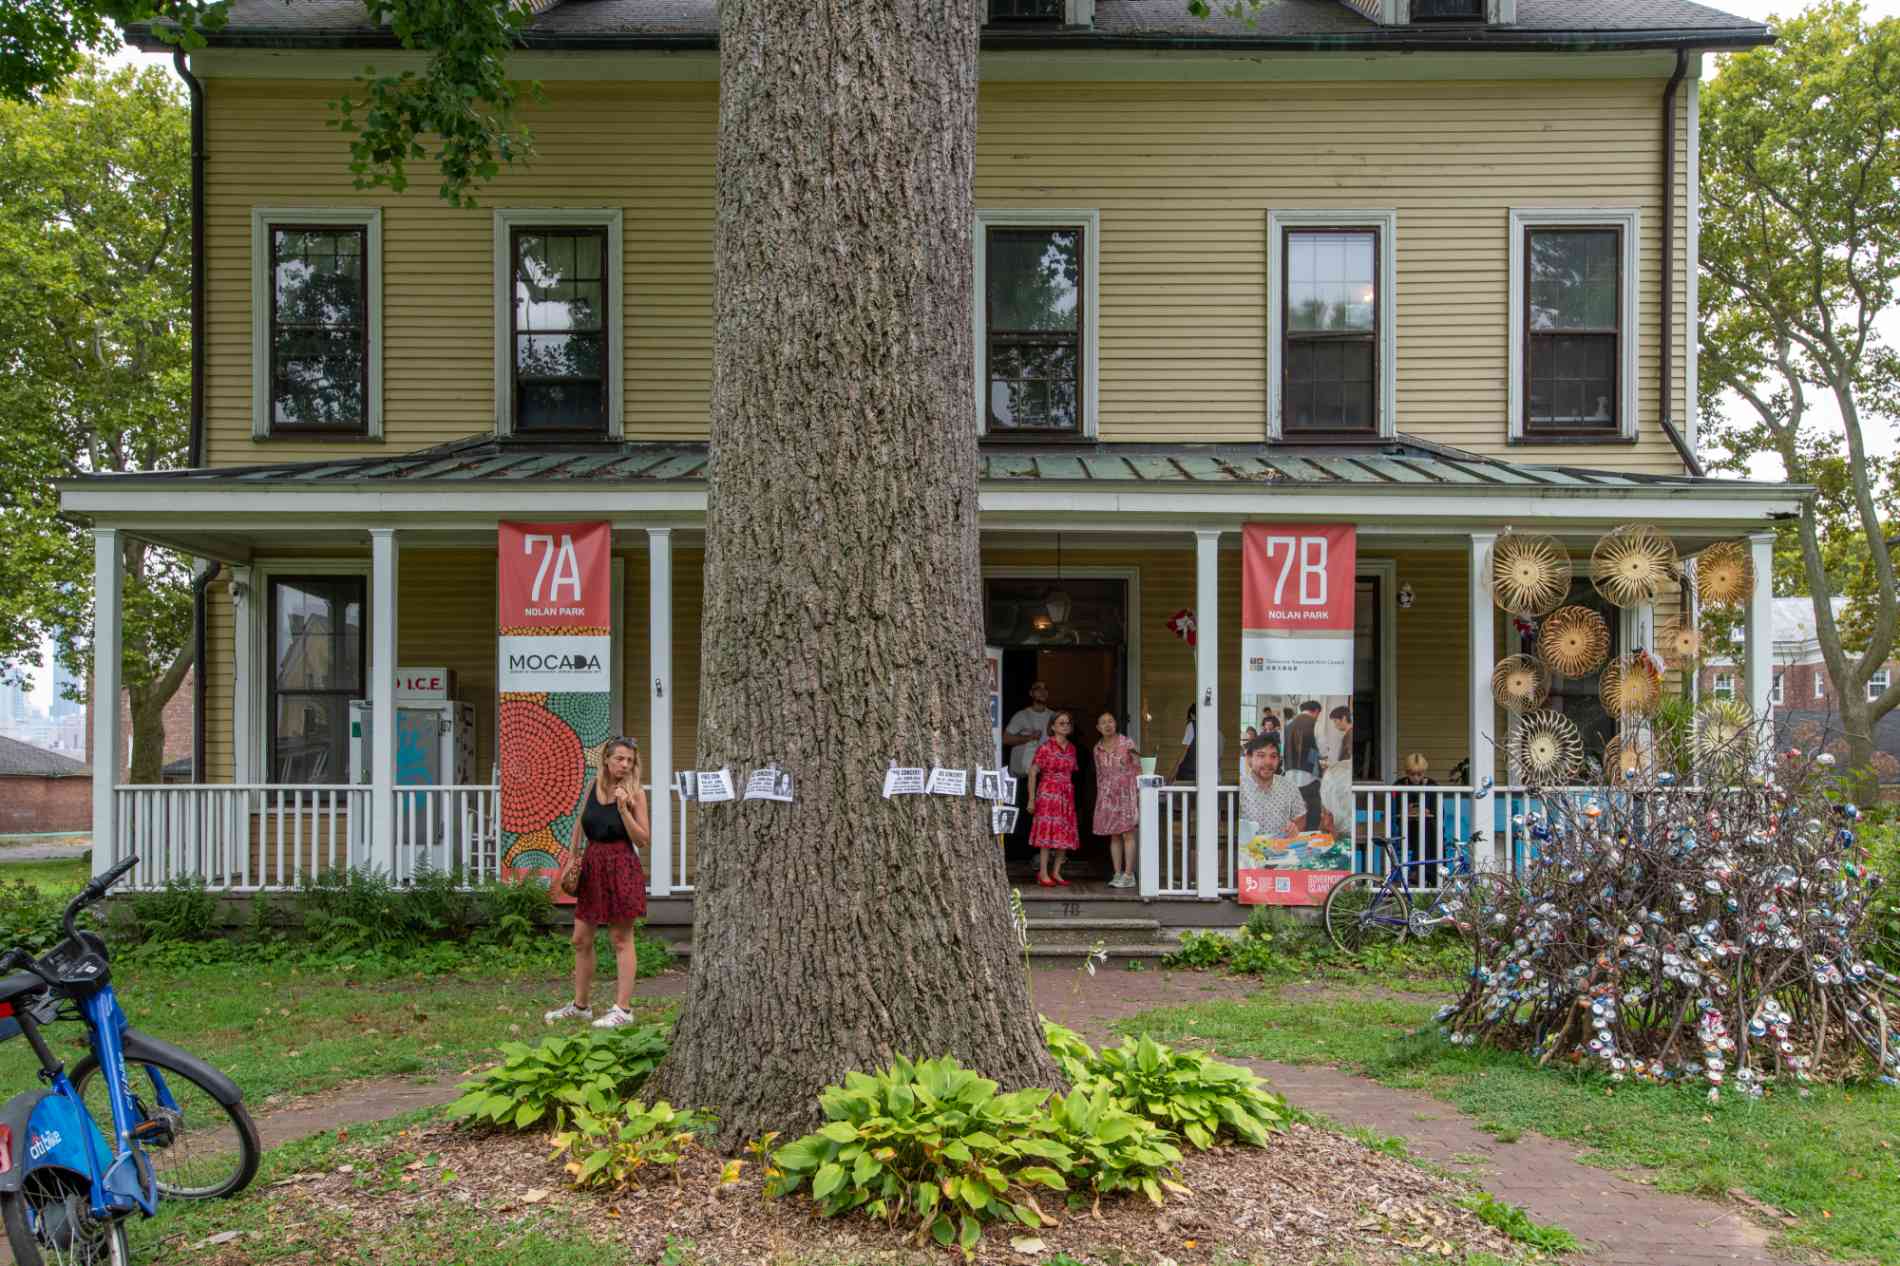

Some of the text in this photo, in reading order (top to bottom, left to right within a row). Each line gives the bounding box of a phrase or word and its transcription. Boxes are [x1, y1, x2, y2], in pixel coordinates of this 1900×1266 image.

[524, 534, 582, 601] 7A
[1266, 535, 1329, 606] 7B
[524, 607, 585, 617] NOLAN PARK
[1268, 610, 1329, 620] NOLAN PARK
[509, 654, 601, 670] MOCADA
[1061, 903, 1081, 917] 7B
